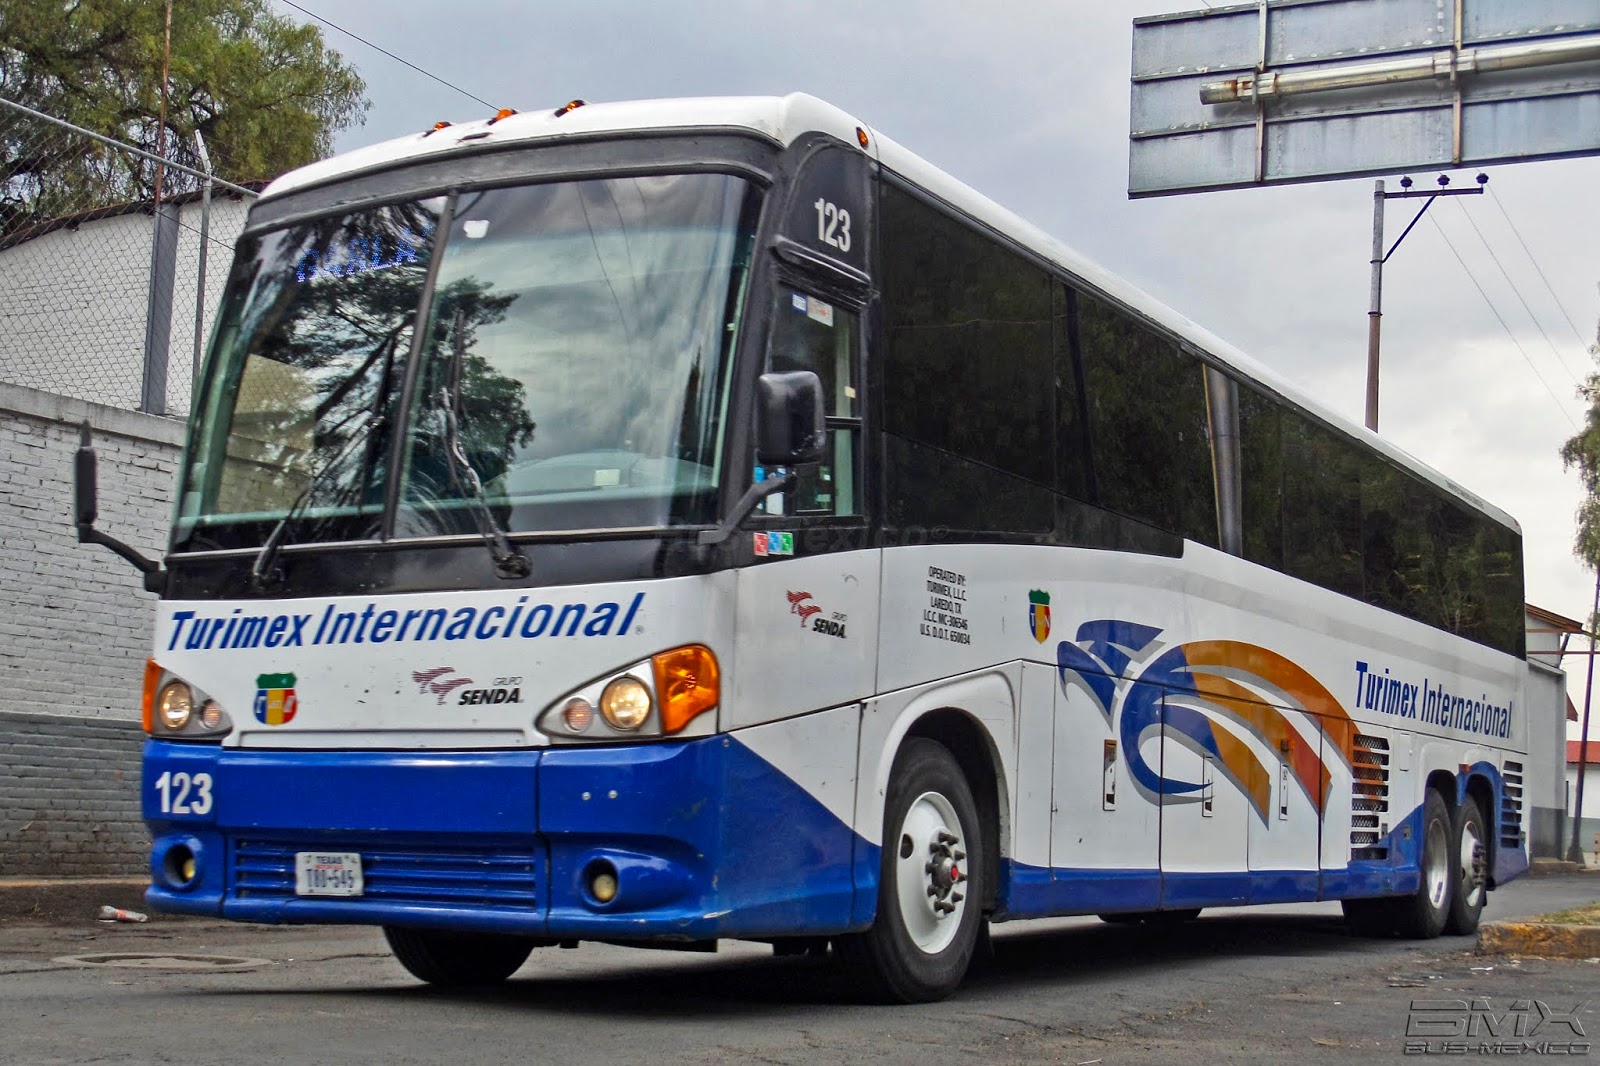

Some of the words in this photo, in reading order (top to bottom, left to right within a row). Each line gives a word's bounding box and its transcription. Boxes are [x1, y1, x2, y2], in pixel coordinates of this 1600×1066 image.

[815, 197, 851, 252] 123
[928, 566, 957, 583] OPERATED
[167, 607, 313, 652] Turimex
[313, 592, 646, 646] Internacional
[954, 602, 962, 615] TX
[812, 617, 847, 639] SENDA
[458, 687, 521, 706] SENDA
[1355, 660, 1419, 720] Turimex
[1420, 678, 1513, 739] Internacional
[154, 770, 214, 815] 123
